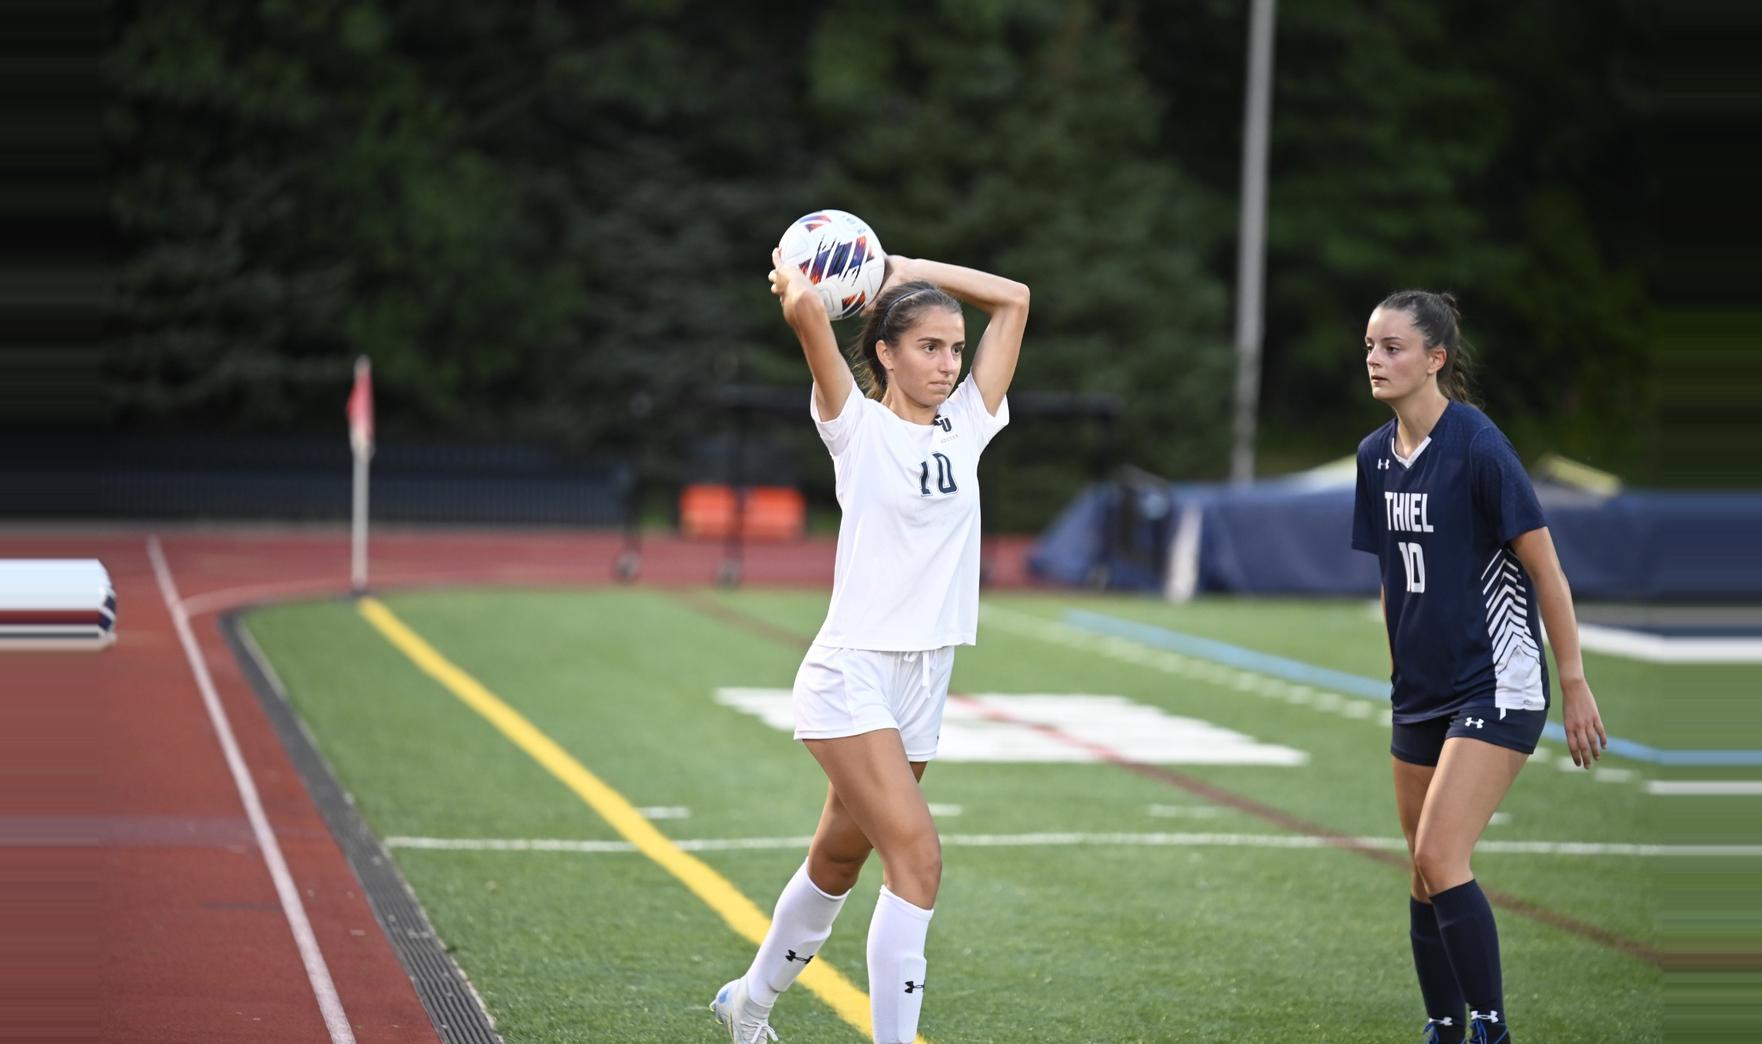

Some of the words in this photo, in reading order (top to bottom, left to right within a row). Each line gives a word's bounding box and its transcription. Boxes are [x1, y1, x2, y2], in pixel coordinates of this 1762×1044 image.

[920, 452, 958, 495] 10
[1384, 491, 1434, 533] THIEL
[1398, 541, 1426, 594] 10
